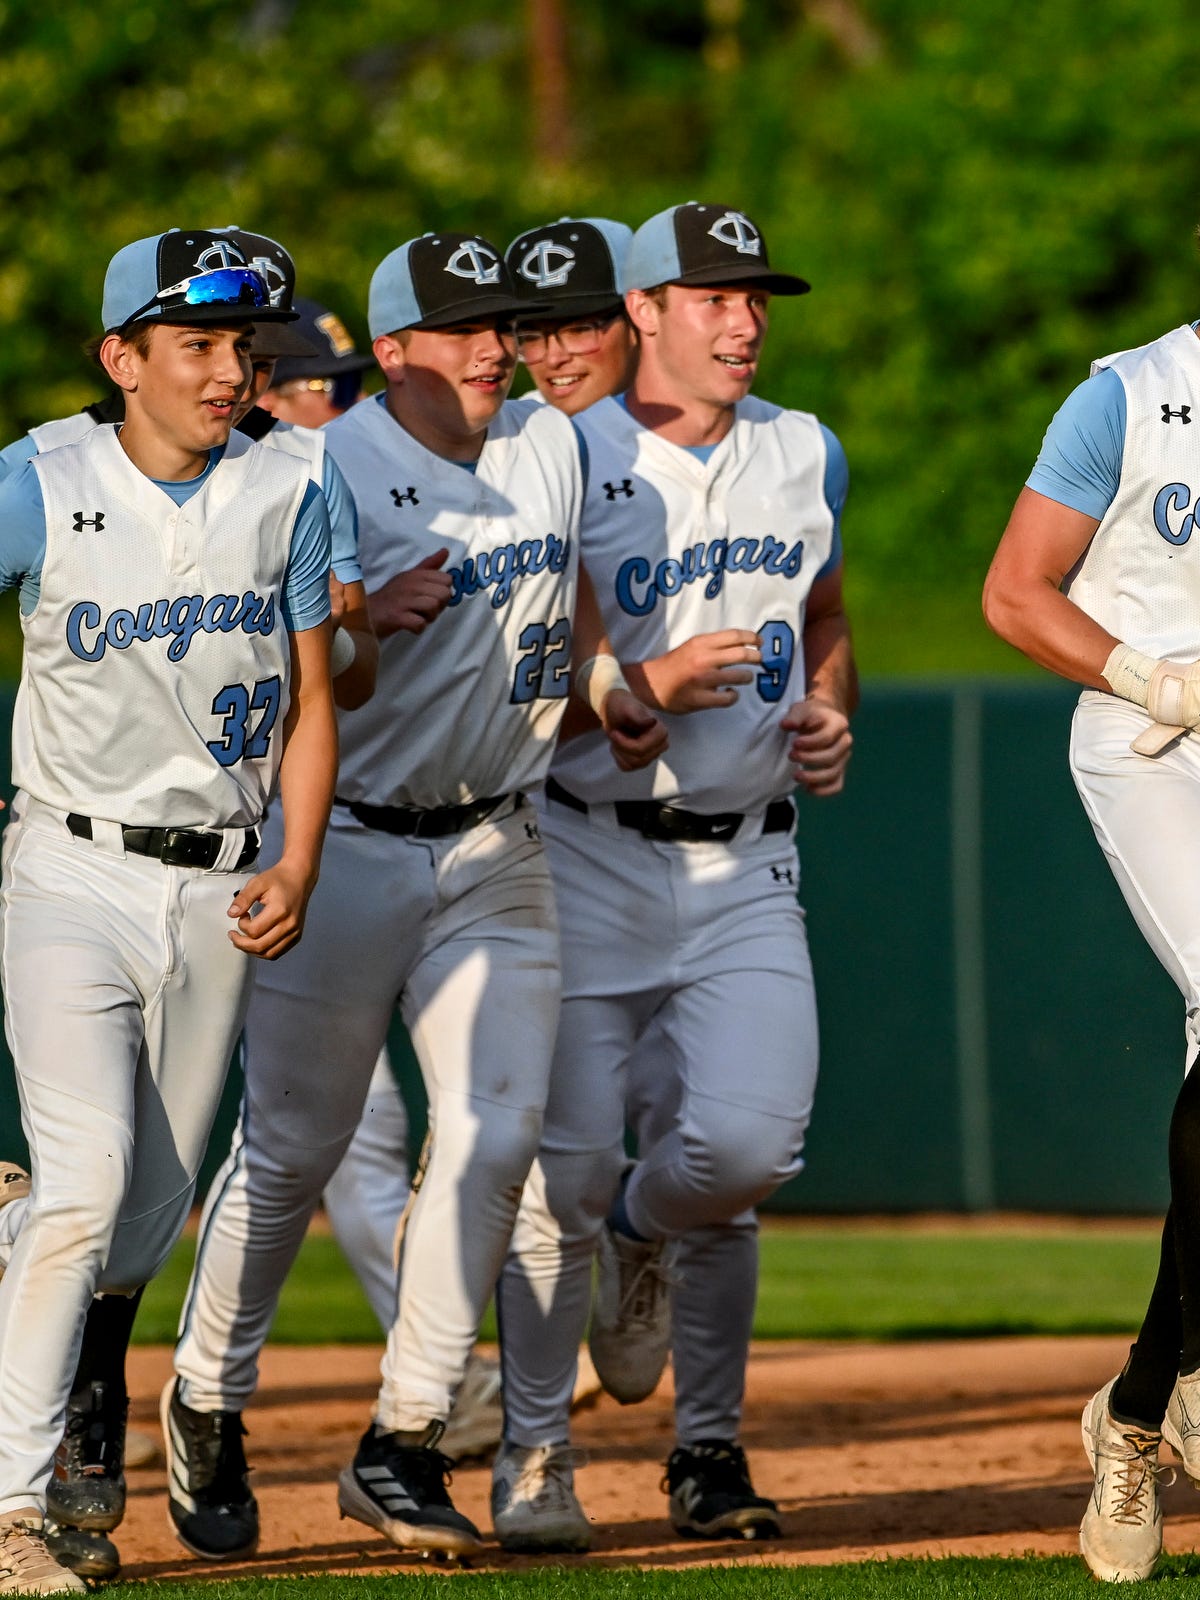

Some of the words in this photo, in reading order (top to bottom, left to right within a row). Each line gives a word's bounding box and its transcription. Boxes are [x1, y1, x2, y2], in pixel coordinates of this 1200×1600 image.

[447, 533, 571, 609] ougar
[615, 535, 803, 616] Cougars
[66, 590, 276, 662] Cougars
[509, 618, 571, 704] 22
[756, 620, 795, 703] 9
[206, 674, 281, 767] 37
